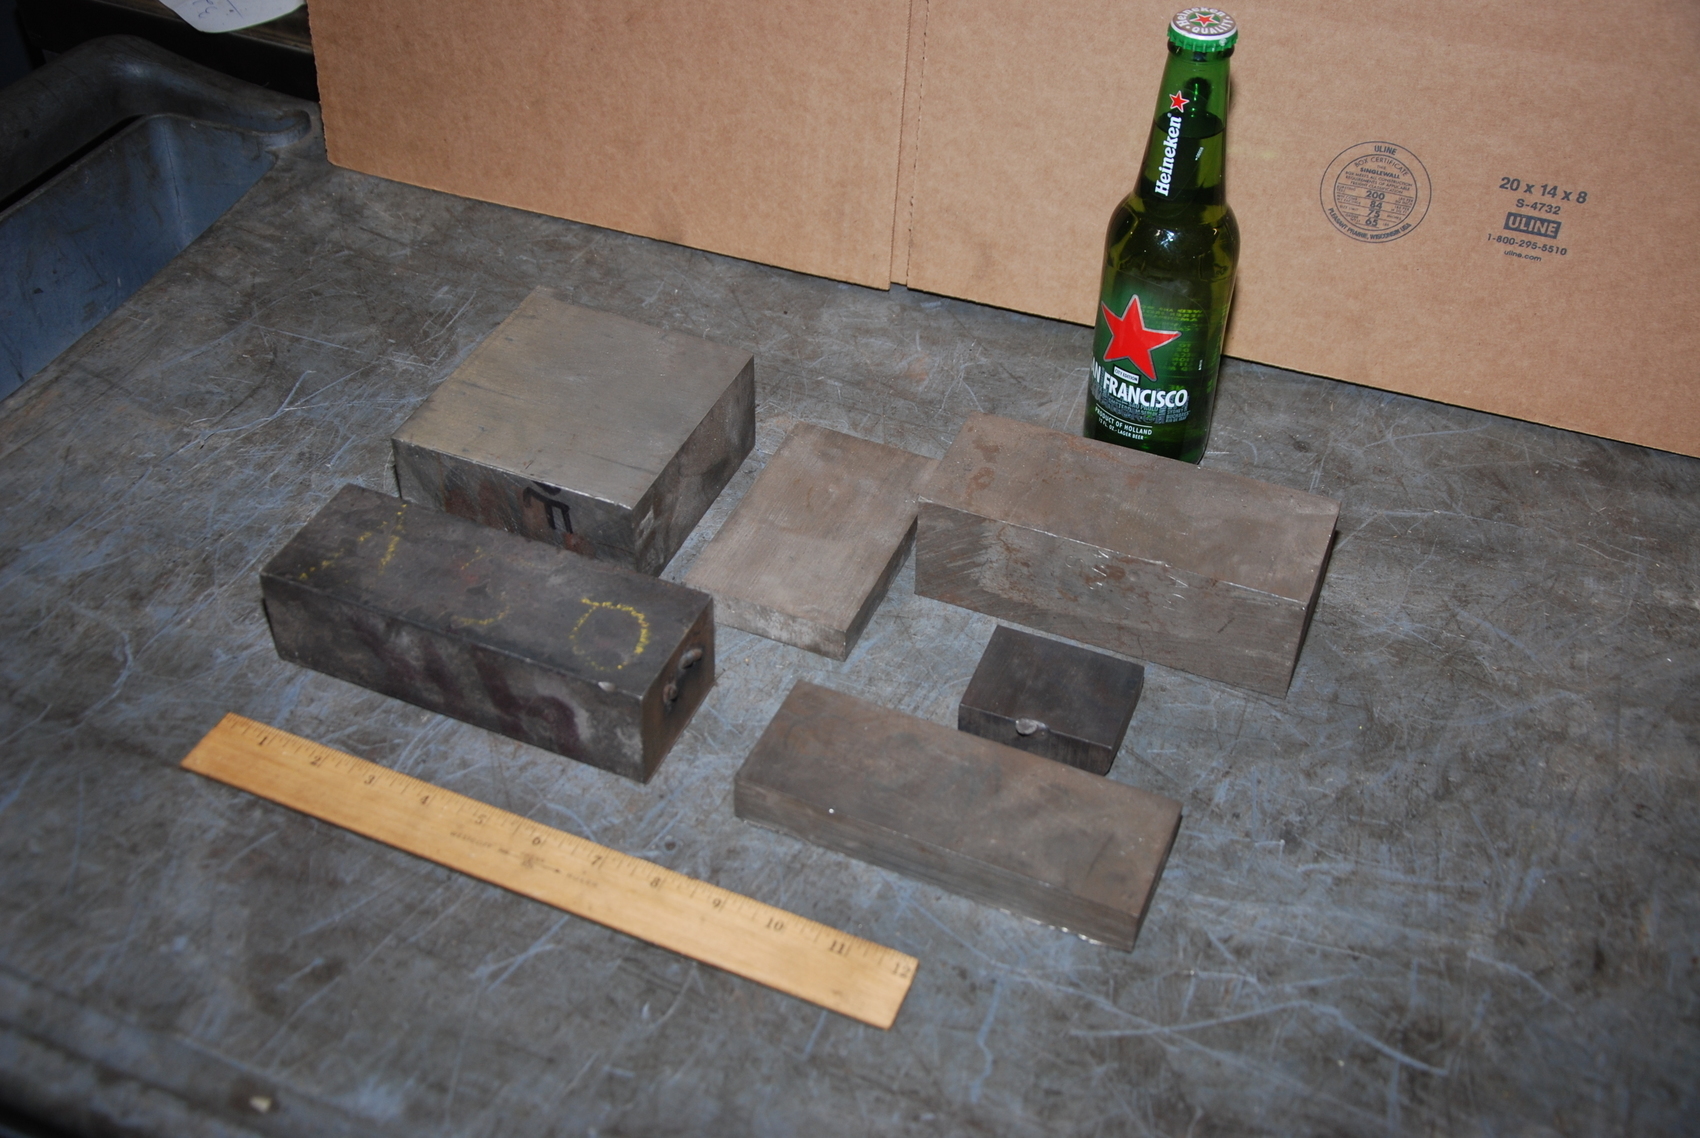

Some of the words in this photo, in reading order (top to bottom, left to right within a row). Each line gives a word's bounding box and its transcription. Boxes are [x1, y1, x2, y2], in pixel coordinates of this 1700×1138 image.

[1176, 7, 1226, 27] Heineken
[1191, 19, 1234, 34] QUALITY
[1155, 116, 1182, 196] Heineken
[1374, 145, 1398, 156] ULINE
[1354, 158, 1368, 168] BOX
[1370, 156, 1409, 176] CERTIFICATE
[1360, 167, 1400, 180] SINGLEWALL
[1366, 190, 1386, 200] 200
[1499, 176, 1521, 192] 20
[1524, 184, 1535, 194] x
[1540, 184, 1558, 198] 14
[1561, 190, 1573, 202] x
[1576, 191, 1588, 204] 8
[1367, 209, 1380, 218] 75
[1370, 200, 1382, 210] 84
[1516, 198, 1561, 215] S-4732
[1365, 218, 1378, 227] 65
[1507, 215, 1558, 236] ULINE
[1487, 233, 1568, 256] 1-800-295-5510
[1504, 250, 1542, 262] uline.com
[1103, 372, 1188, 408] FRANCISCO
[1095, 406, 1115, 424] PRODUCT
[1124, 424, 1152, 436] HOLLAND
[1118, 429, 1131, 438] LAGER
[258, 735, 269, 747] 1
[310, 755, 323, 768] 2
[364, 774, 376, 786] 3
[419, 794, 431, 806] 4
[475, 814, 487, 826] 5
[591, 854, 603, 866] 7
[650, 876, 662, 889] 8
[712, 898, 722, 910] 9
[764, 916, 785, 933] 10
[828, 939, 846, 956] 11
[890, 960, 913, 979] 12
